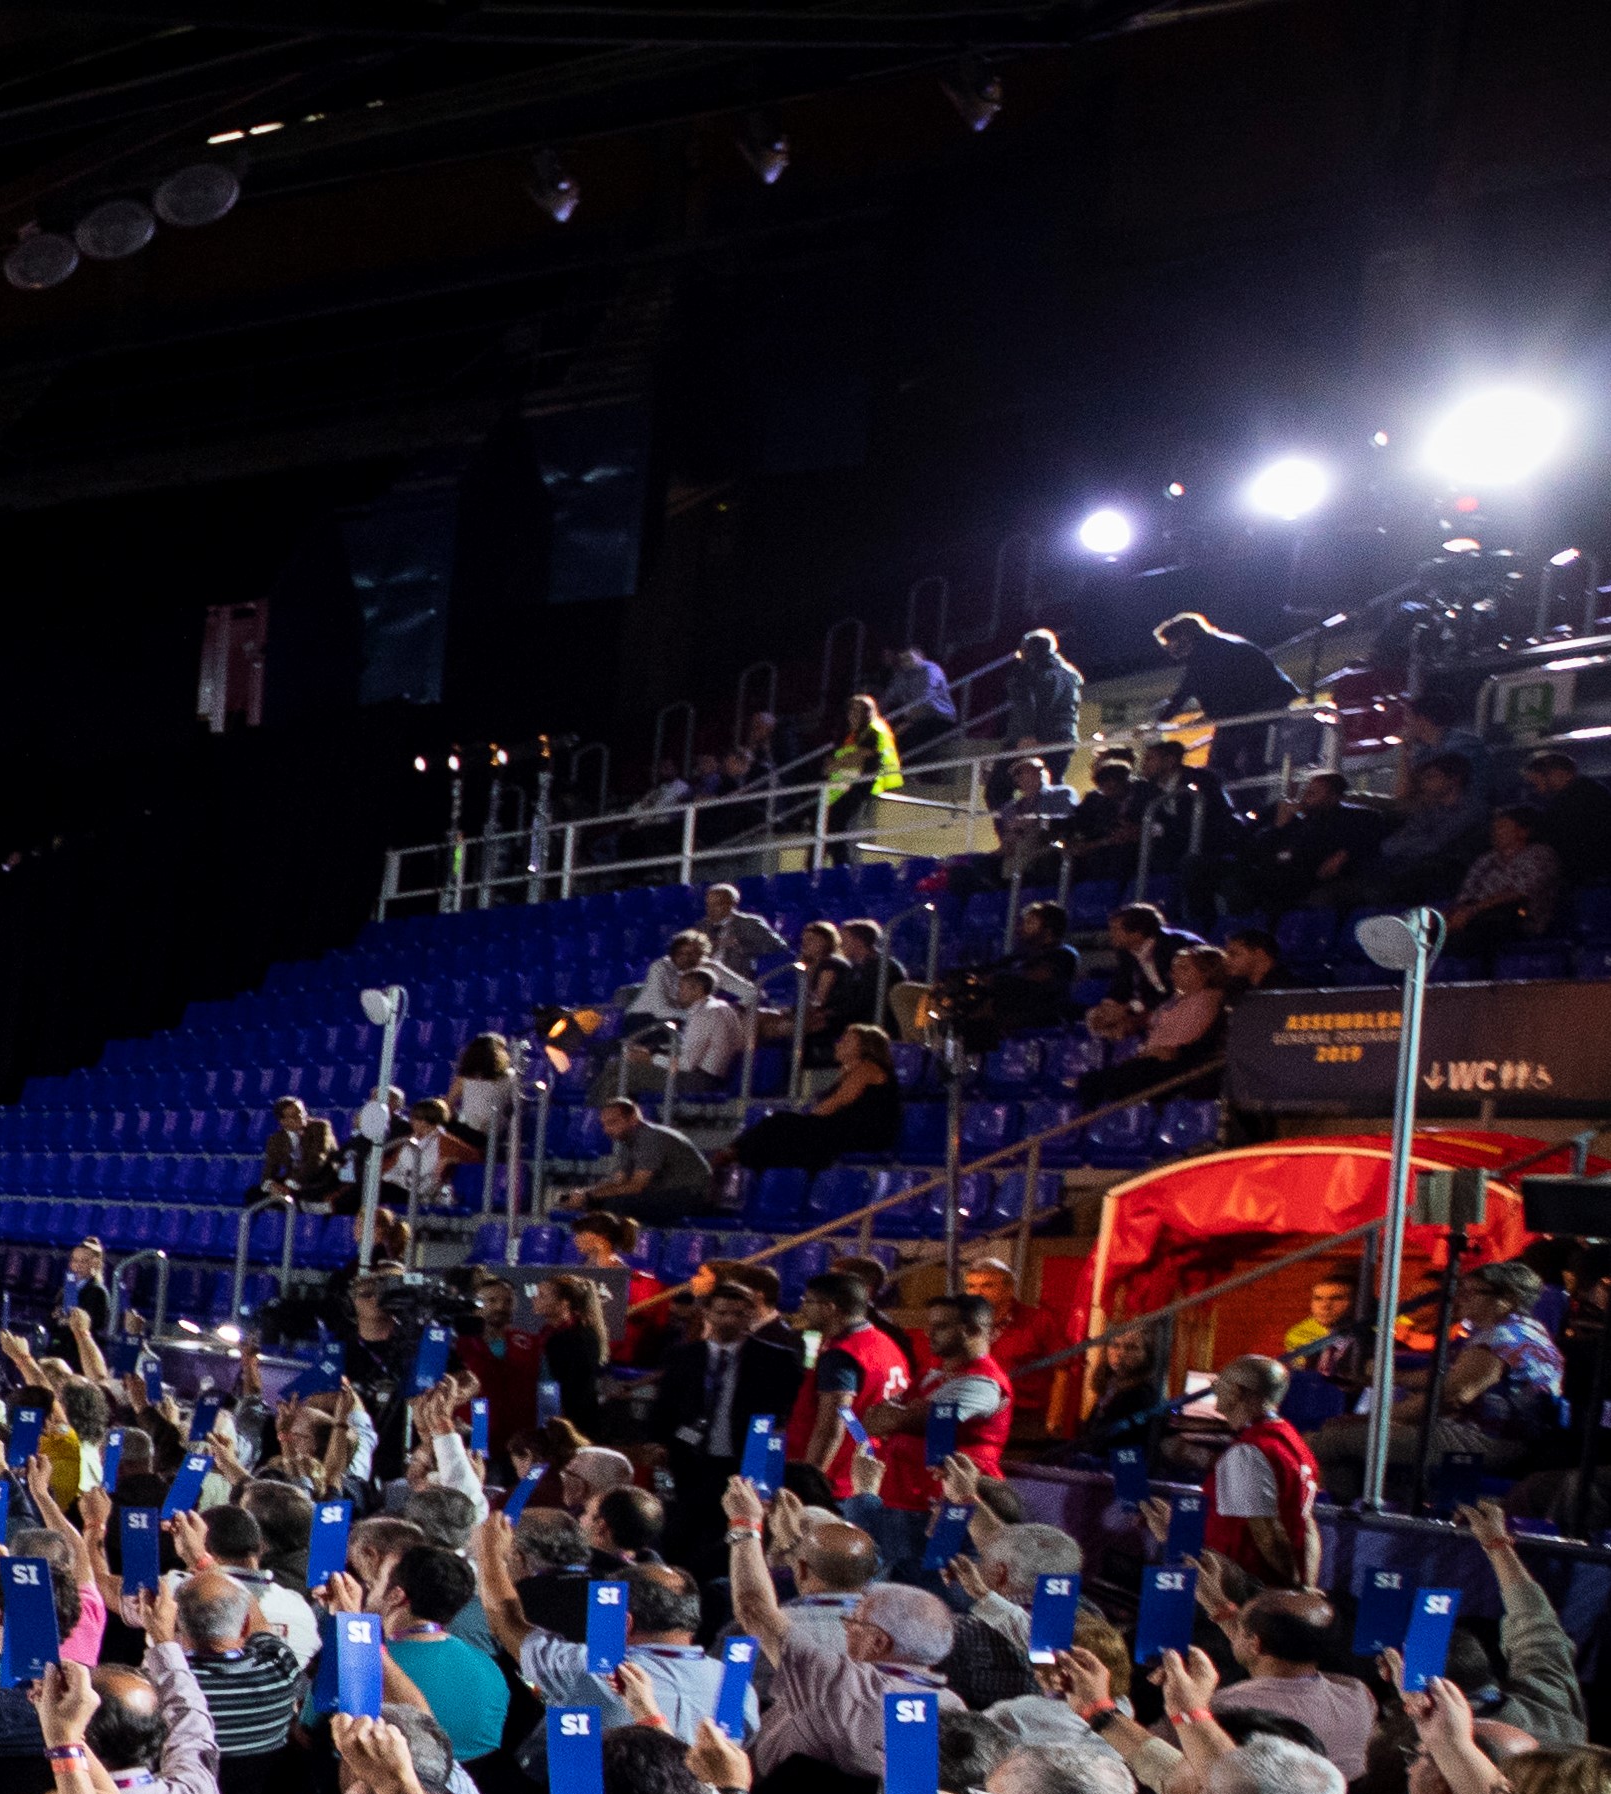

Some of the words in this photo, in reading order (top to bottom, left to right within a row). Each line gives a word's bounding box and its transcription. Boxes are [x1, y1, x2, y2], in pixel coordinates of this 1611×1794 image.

[1448, 1060, 1497, 1092] WC
[754, 1419, 770, 1433] SI
[187, 1457, 206, 1471] SI
[129, 1513, 148, 1528] SI
[321, 1506, 343, 1523] SI
[12, 1564, 40, 1585] SI
[1156, 1572, 1185, 1590] SI
[1374, 1572, 1401, 1589] SI
[1045, 1579, 1070, 1595] SI
[598, 1588, 619, 1604] SI
[1426, 1596, 1451, 1613] SI
[347, 1621, 371, 1643] SI
[729, 1644, 751, 1662] SI
[896, 1700, 925, 1722] SI
[561, 1714, 589, 1735] SI
